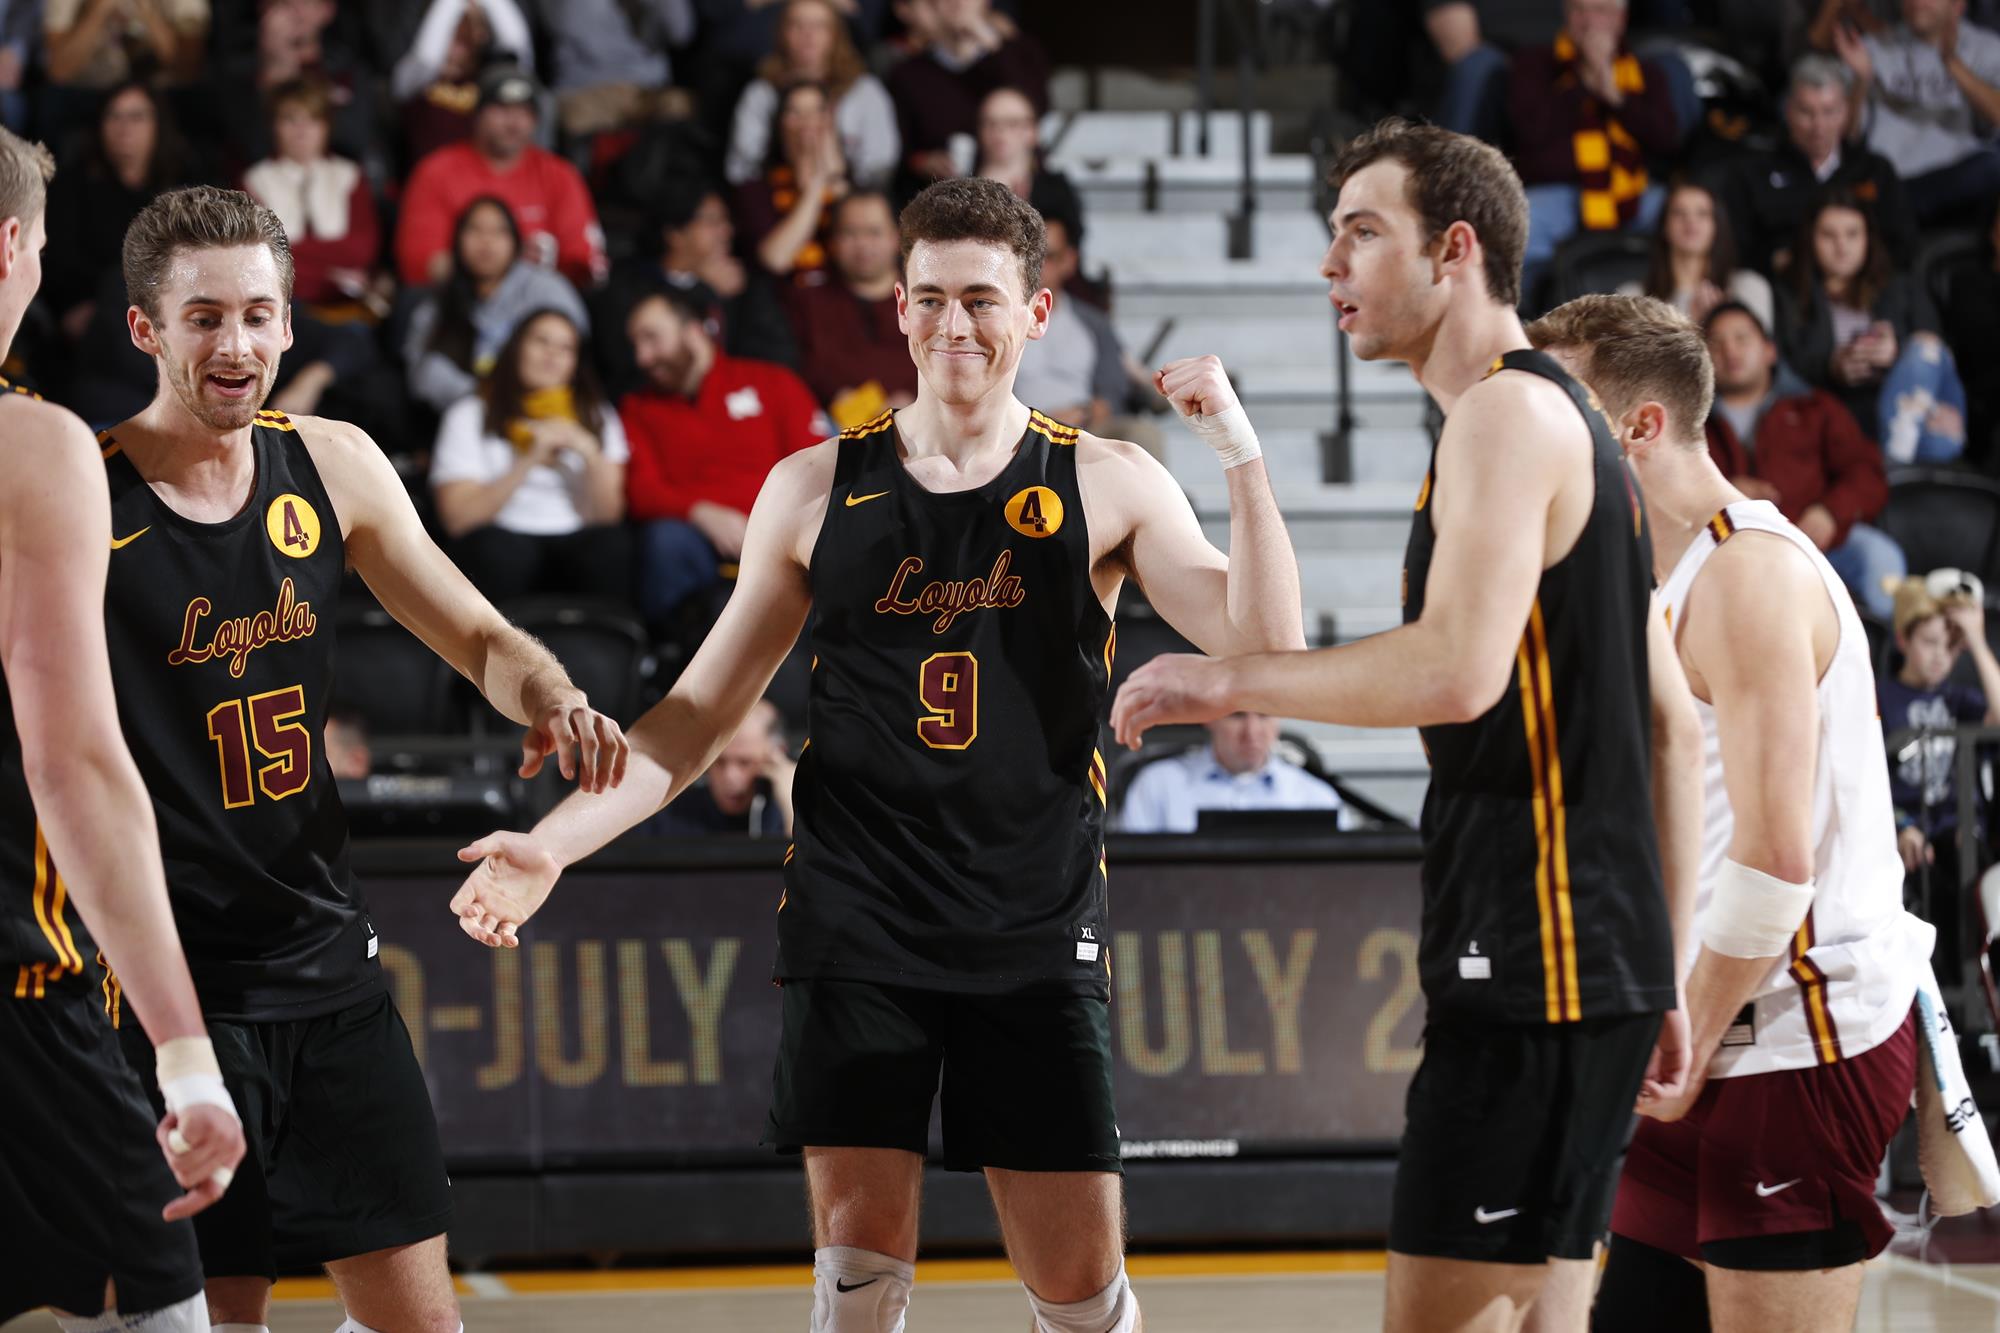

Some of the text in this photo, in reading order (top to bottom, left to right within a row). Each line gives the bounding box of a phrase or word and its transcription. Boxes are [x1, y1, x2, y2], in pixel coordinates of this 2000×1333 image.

[283, 500, 309, 551] 4
[1019, 490, 1047, 532] 4
[167, 576, 317, 678] Loyola
[874, 549, 1026, 634] Loyola
[916, 650, 979, 750] 9
[206, 684, 311, 810] 15
[1080, 926, 1096, 940] XL
